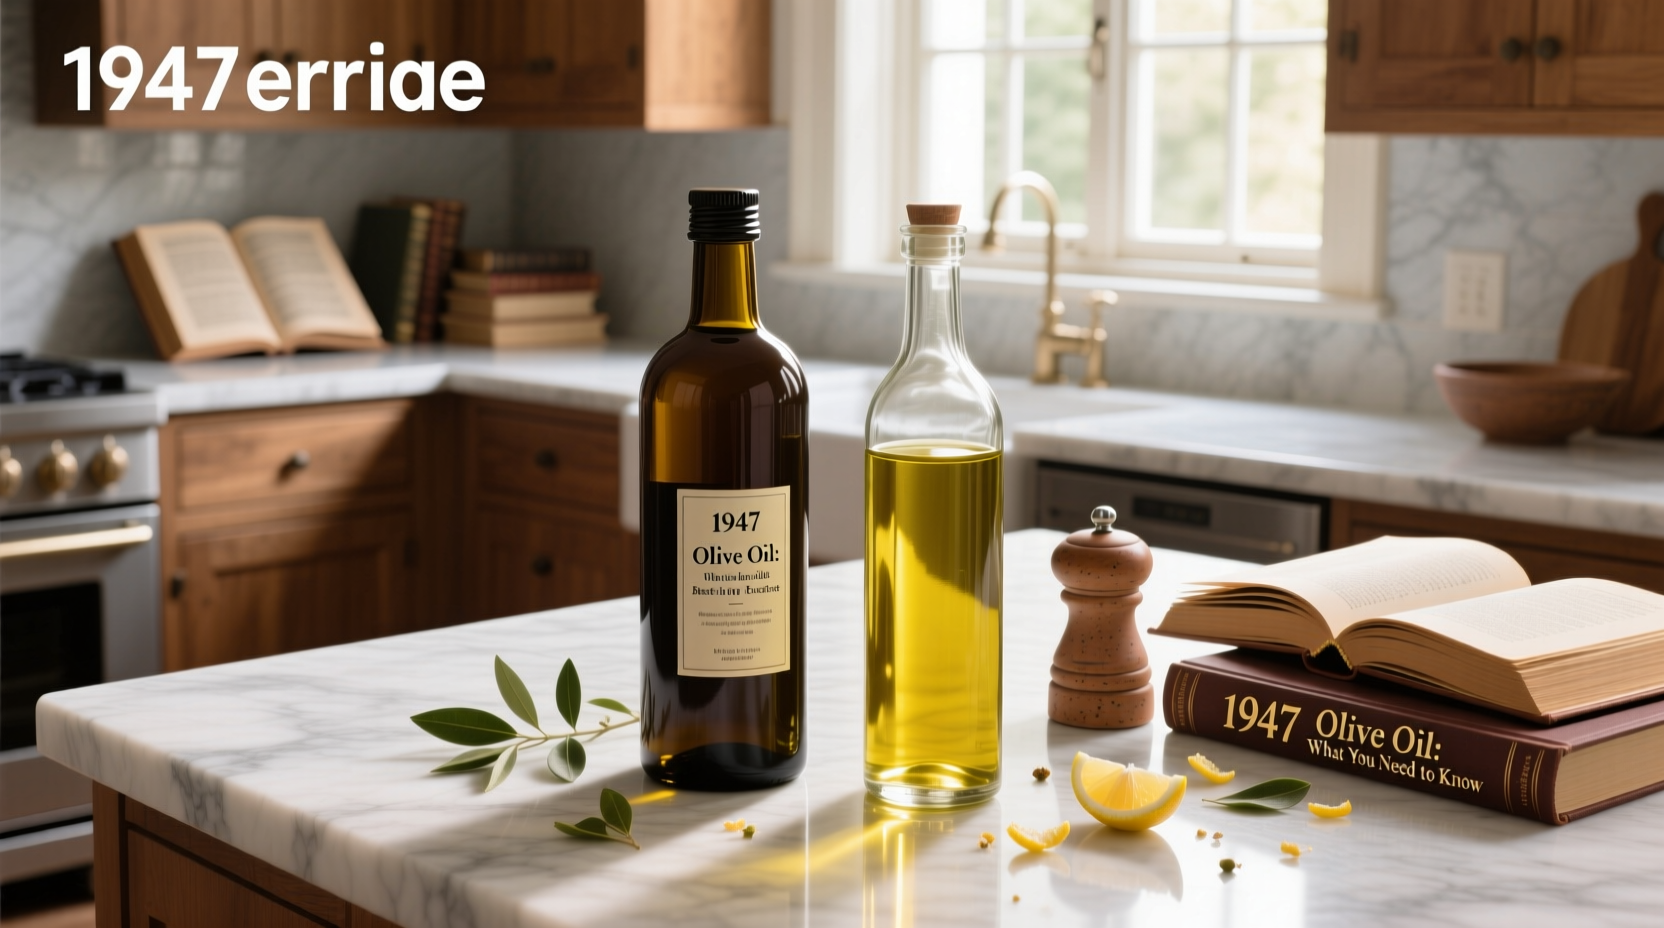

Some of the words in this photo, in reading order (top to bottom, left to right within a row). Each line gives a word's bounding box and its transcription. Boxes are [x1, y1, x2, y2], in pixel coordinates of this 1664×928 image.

[712, 511, 761, 533] 1947
[692, 545, 743, 565] Olive
[747, 543, 780, 564] Oil:
[1223, 693, 1302, 743] 1947
[1315, 708, 1385, 749] Olive
[1392, 725, 1442, 761] Oil:
[1307, 738, 1344, 762] What
[1348, 746, 1376, 769] You
[1379, 754, 1416, 779] Need
[1420, 766, 1436, 782] to
[1439, 768, 1484, 793] Know
